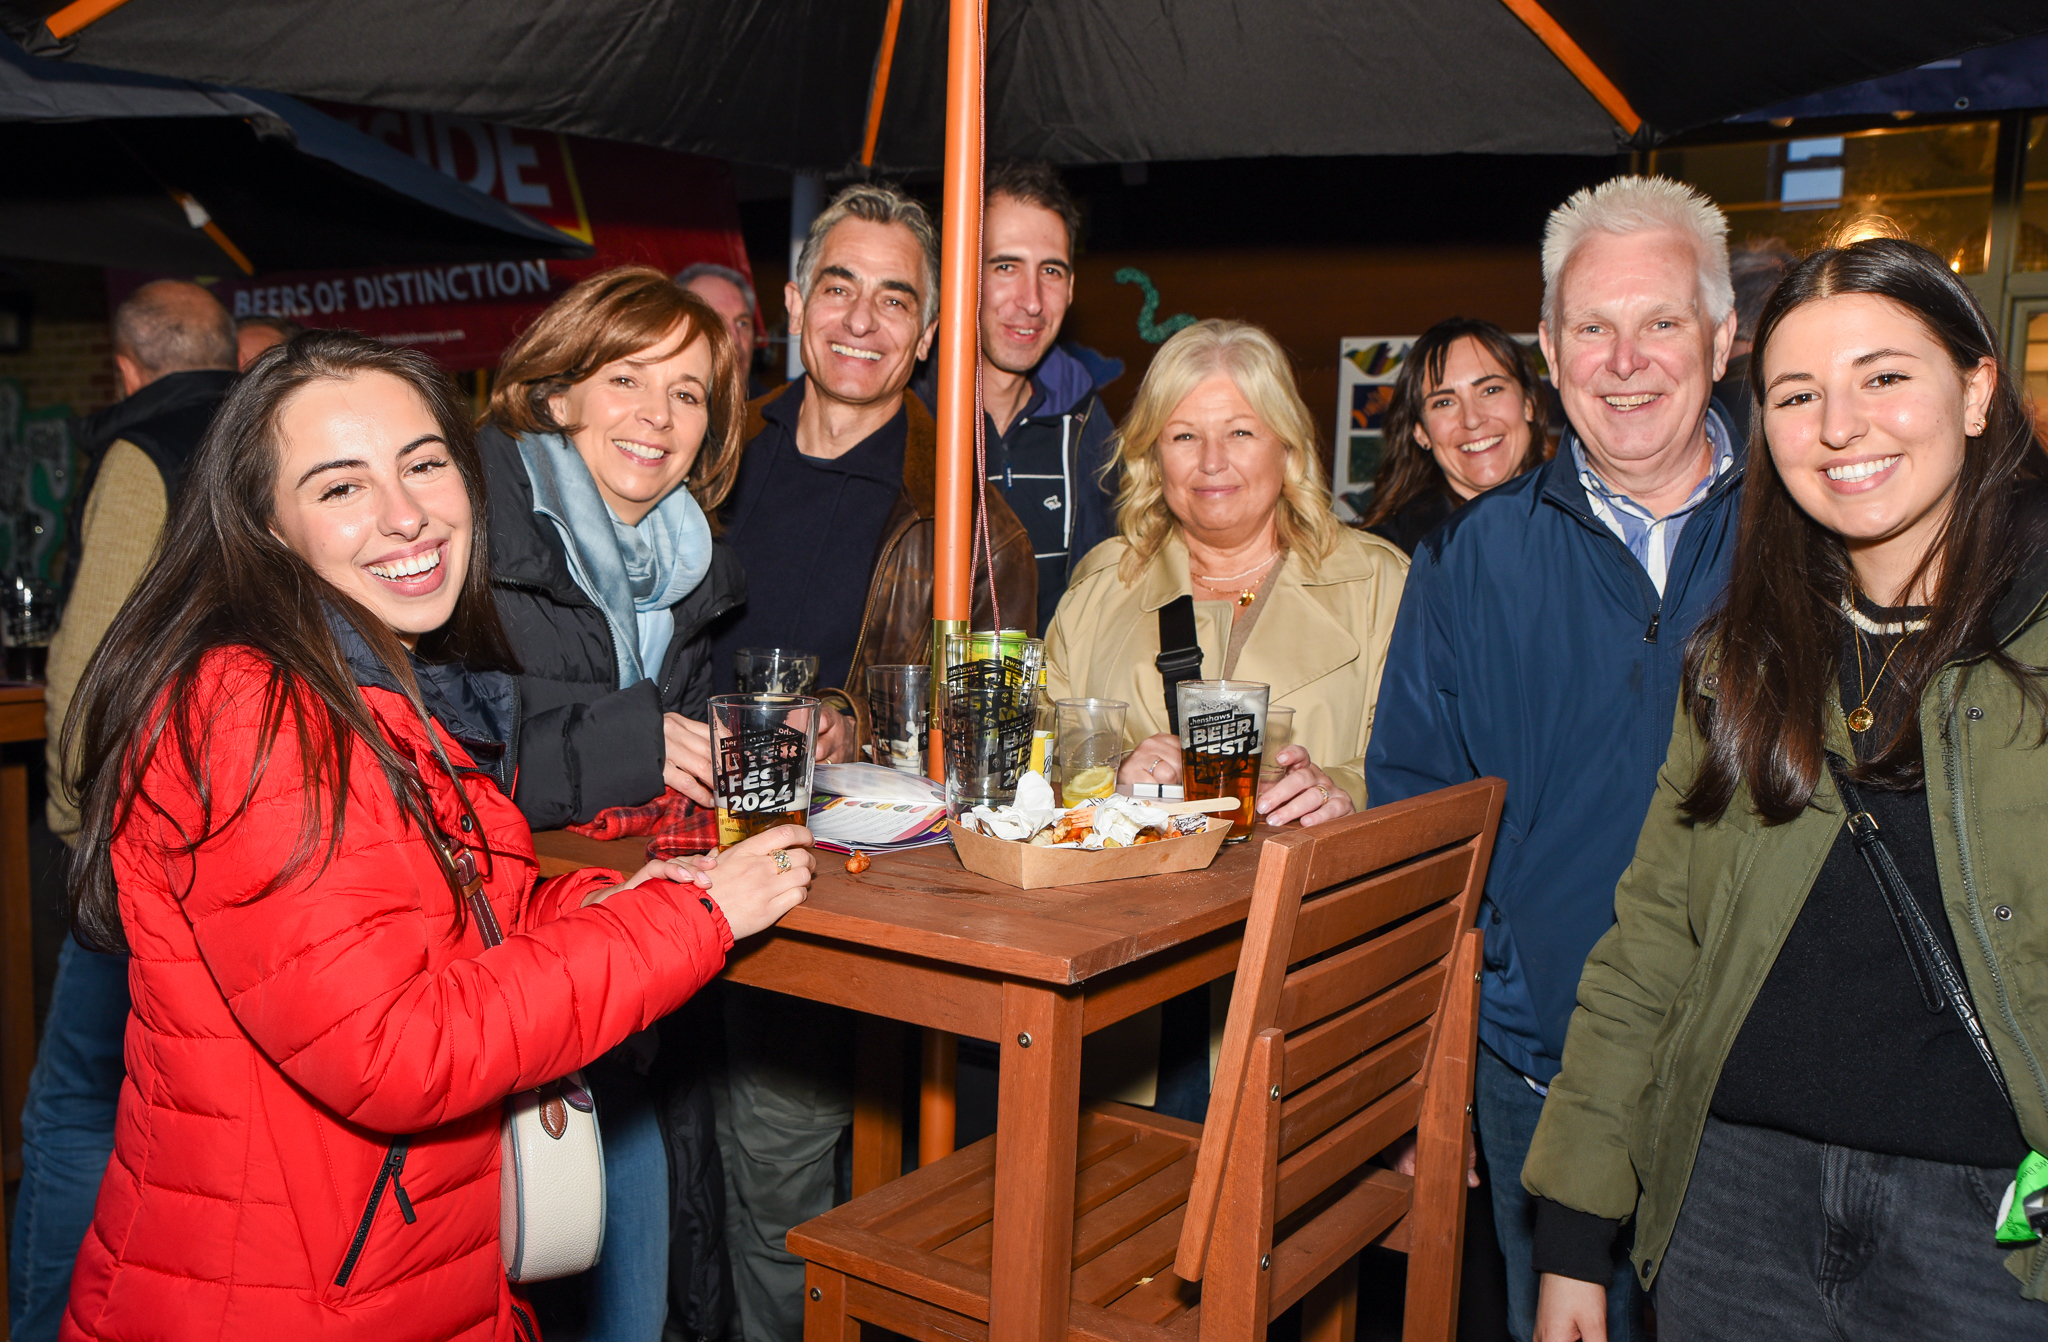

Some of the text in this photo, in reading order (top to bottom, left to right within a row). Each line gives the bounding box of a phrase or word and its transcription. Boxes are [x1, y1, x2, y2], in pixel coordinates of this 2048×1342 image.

[234, 260, 550, 318] BEERS OF DISTINCTION
[1192, 718, 1252, 745] BEER
[1195, 736, 1249, 758] FEST
[728, 763, 793, 793] FEST
[1195, 757, 1248, 780] 2024
[729, 783, 794, 812] 2024
